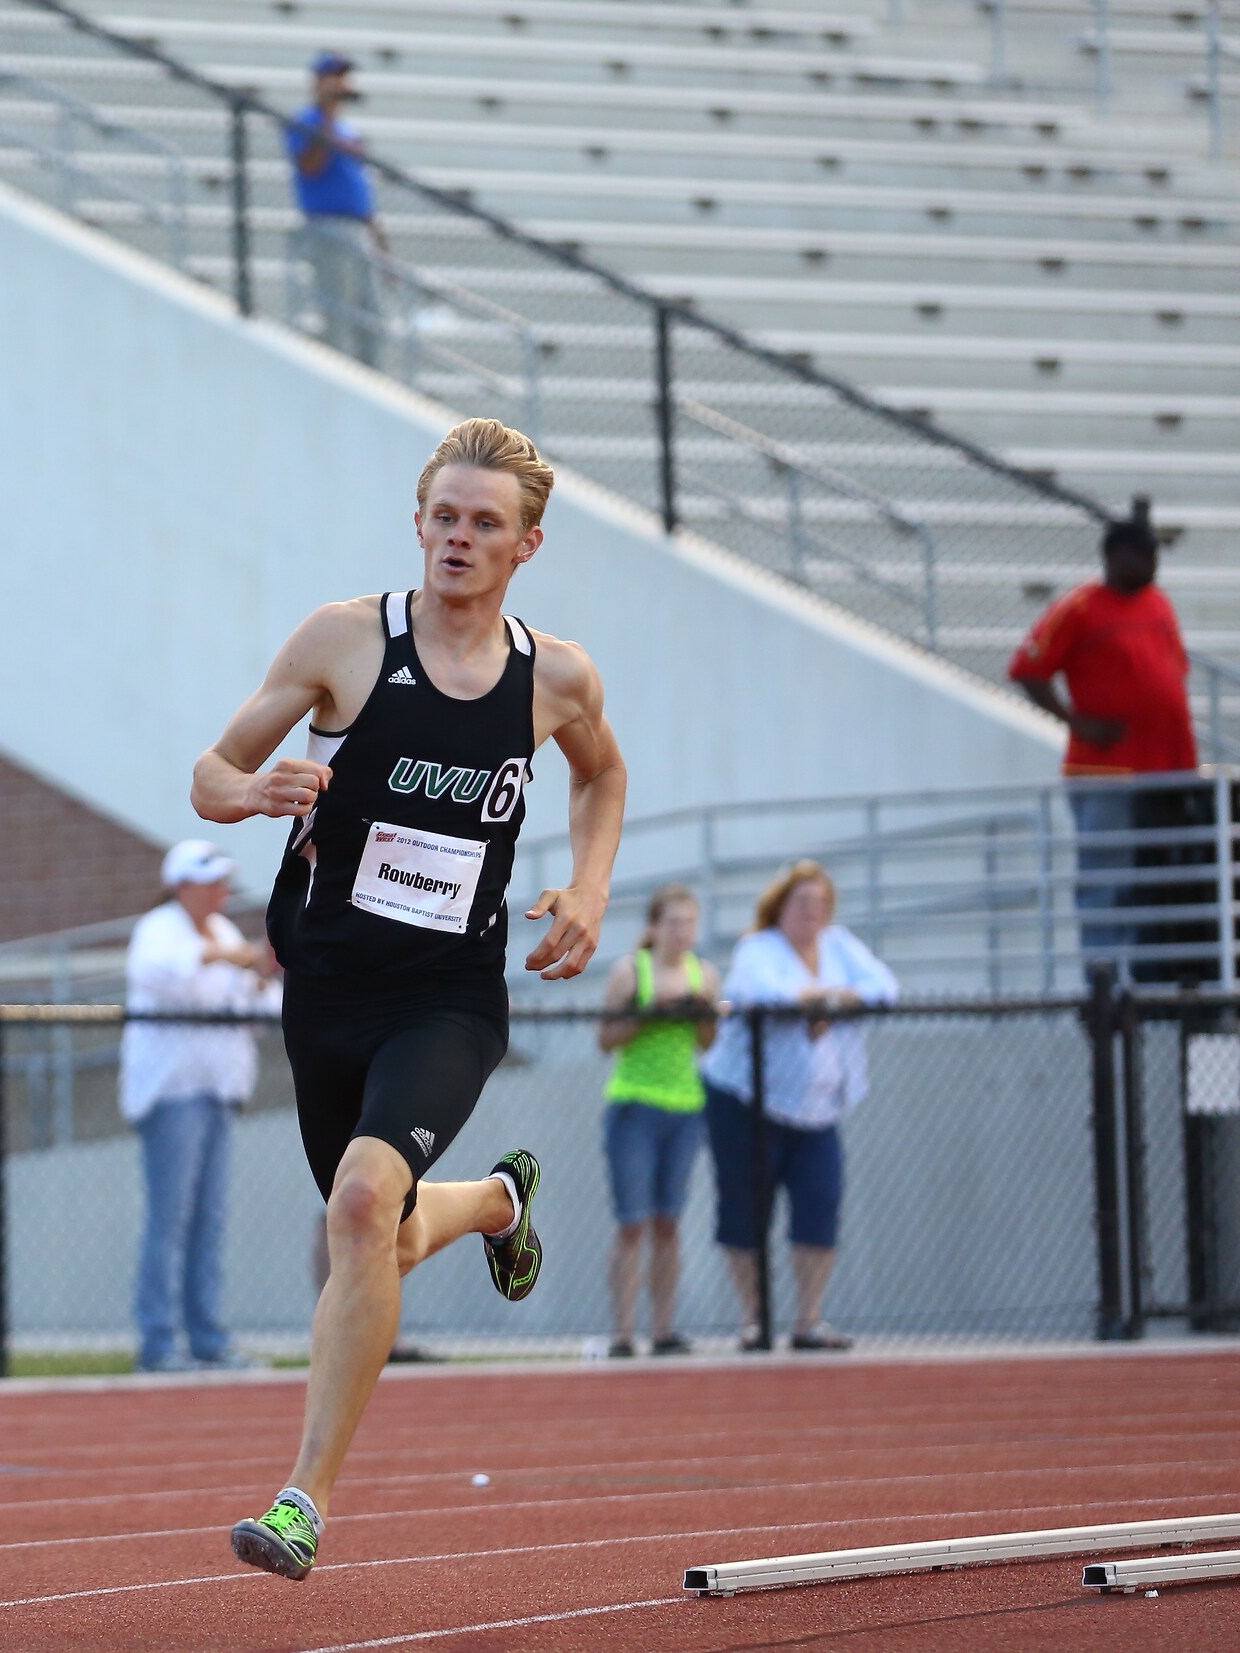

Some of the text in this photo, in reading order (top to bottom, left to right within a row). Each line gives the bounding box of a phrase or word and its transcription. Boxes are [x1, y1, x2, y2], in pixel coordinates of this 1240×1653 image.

[388, 676, 416, 685] adidas
[388, 757, 491, 803] UVU
[487, 763, 519, 818] 6
[397, 837, 481, 858] 2012 OUTDOOR CHAMPIONSHIPS
[377, 863, 462, 900] Rowberry
[355, 892, 376, 903] HOSTED
[385, 900, 410, 912] HOUSTON
[411, 907, 434, 918] BAPTIST
[434, 913, 462, 922] UNIVERSITY
